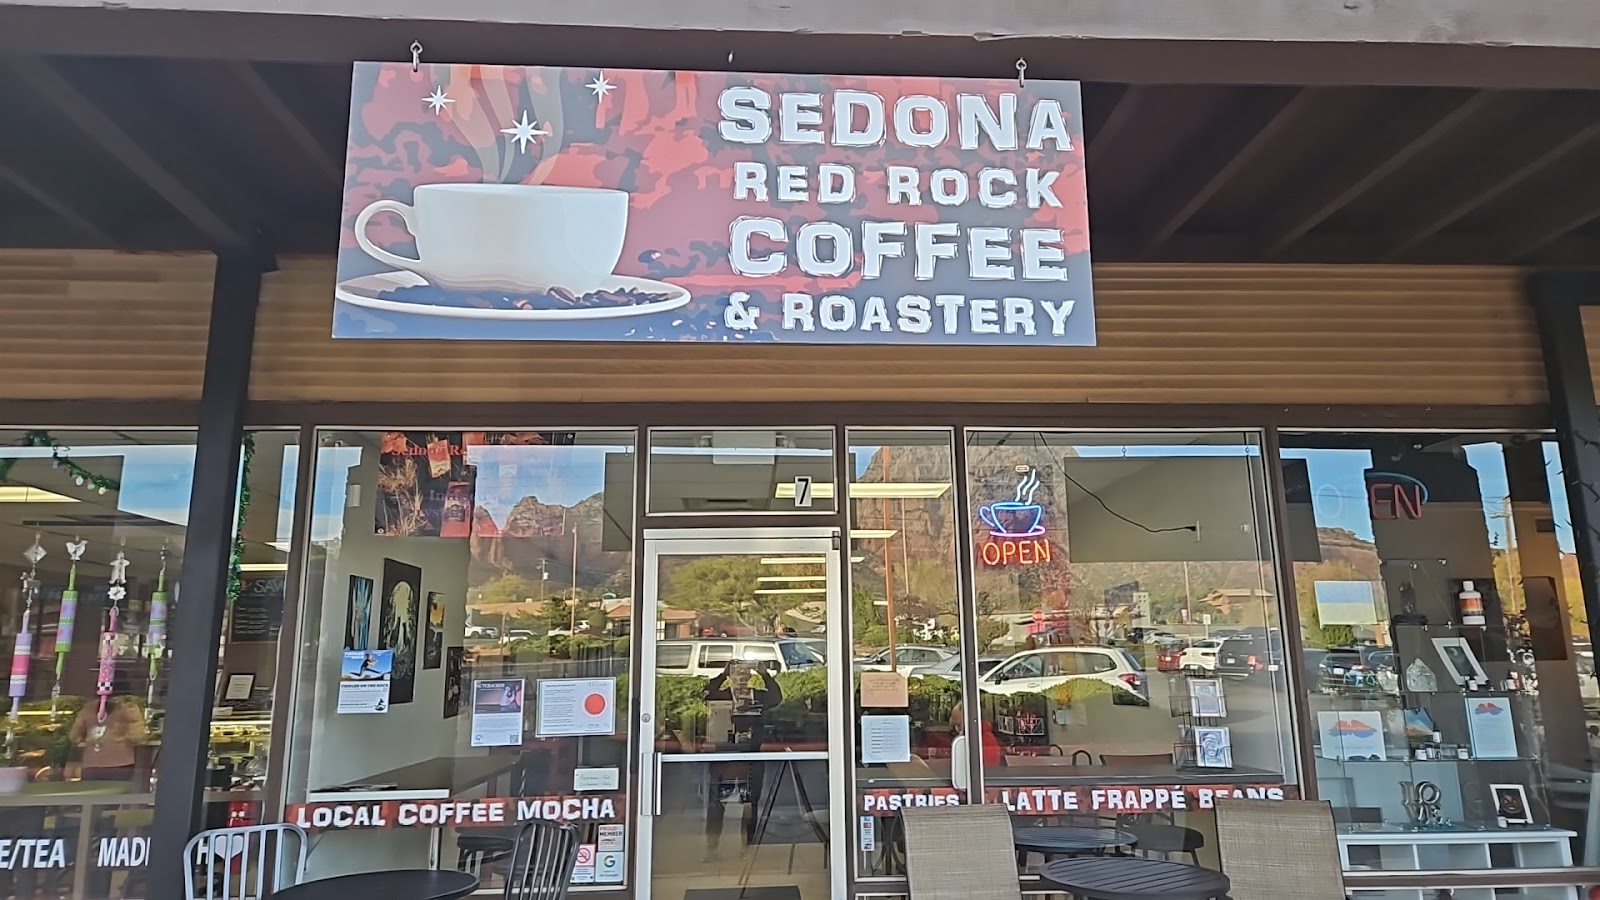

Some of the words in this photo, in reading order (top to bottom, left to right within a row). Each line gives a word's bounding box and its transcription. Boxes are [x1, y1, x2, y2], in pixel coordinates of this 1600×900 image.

[717, 86, 1074, 151] SEDONA
[733, 161, 856, 204] RED
[886, 165, 1064, 209] ROCK
[728, 215, 1068, 281] COFFEE
[724, 291, 759, 331] &
[781, 293, 1075, 337] ROASTERY
[797, 477, 809, 505] 7
[1315, 483, 1422, 520] OEN
[982, 539, 1051, 566] OPEN
[297, 804, 386, 829] LOCAL
[398, 802, 504, 825] COFFEE
[517, 798, 615, 821] MOCHA
[864, 794, 960, 812] PASTRIES
[1002, 790, 1078, 811] LATTE
[1091, 785, 1186, 810] FRAPPÉ
[0, 839, 66, 870] E/TEA
